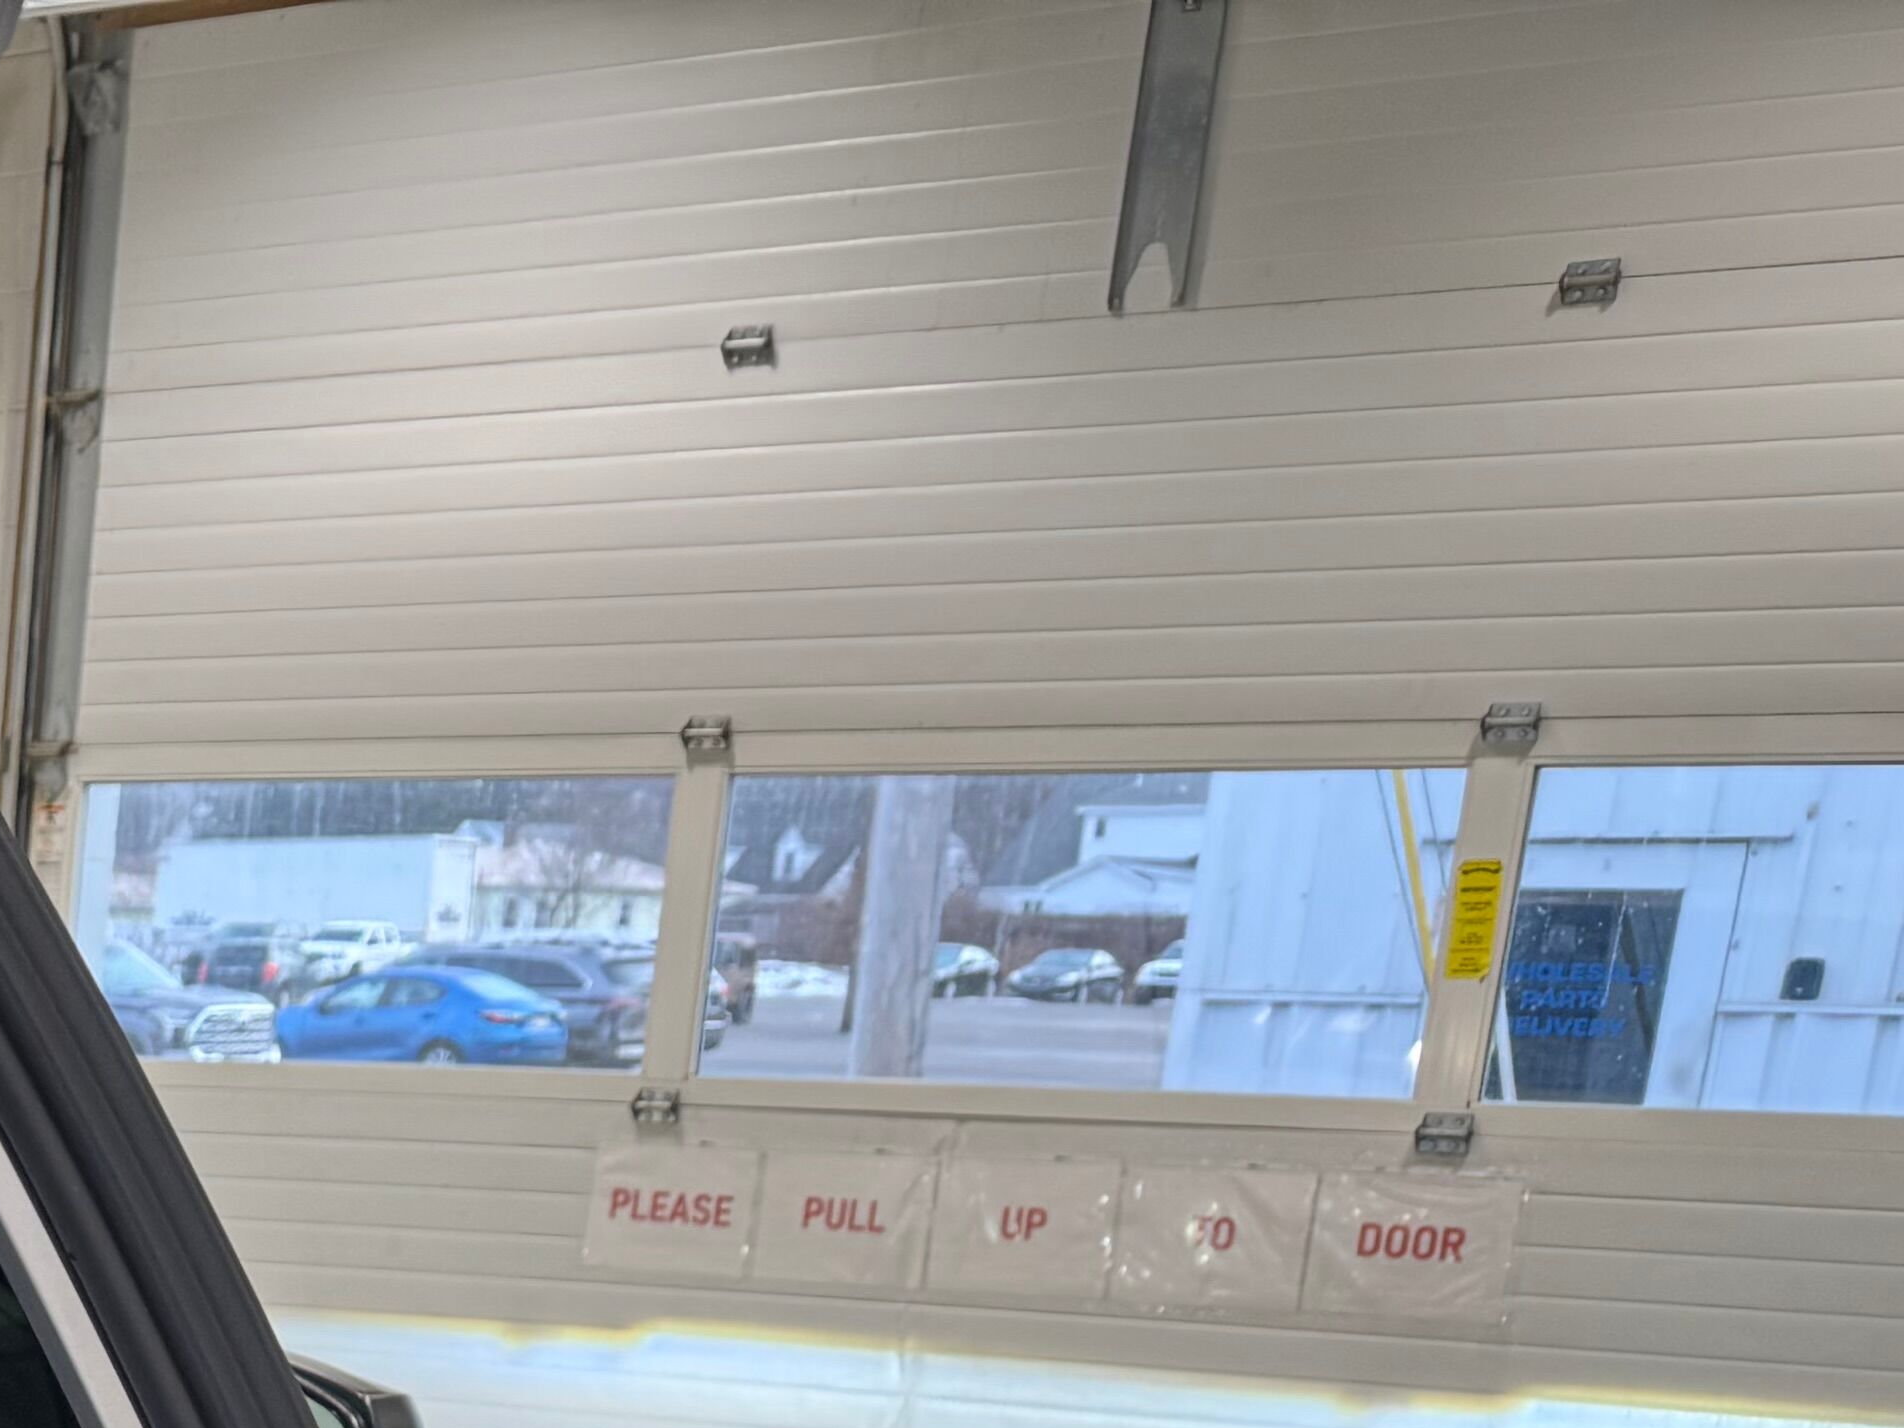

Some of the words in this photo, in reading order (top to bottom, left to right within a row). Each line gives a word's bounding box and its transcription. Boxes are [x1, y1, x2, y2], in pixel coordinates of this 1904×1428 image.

[1512, 1016, 1625, 1037] ELIVERY
[608, 1187, 735, 1228] PLEASE
[802, 1195, 886, 1234] PULL
[999, 1206, 1049, 1241] UP
[1356, 1222, 1467, 1263] DOOR
